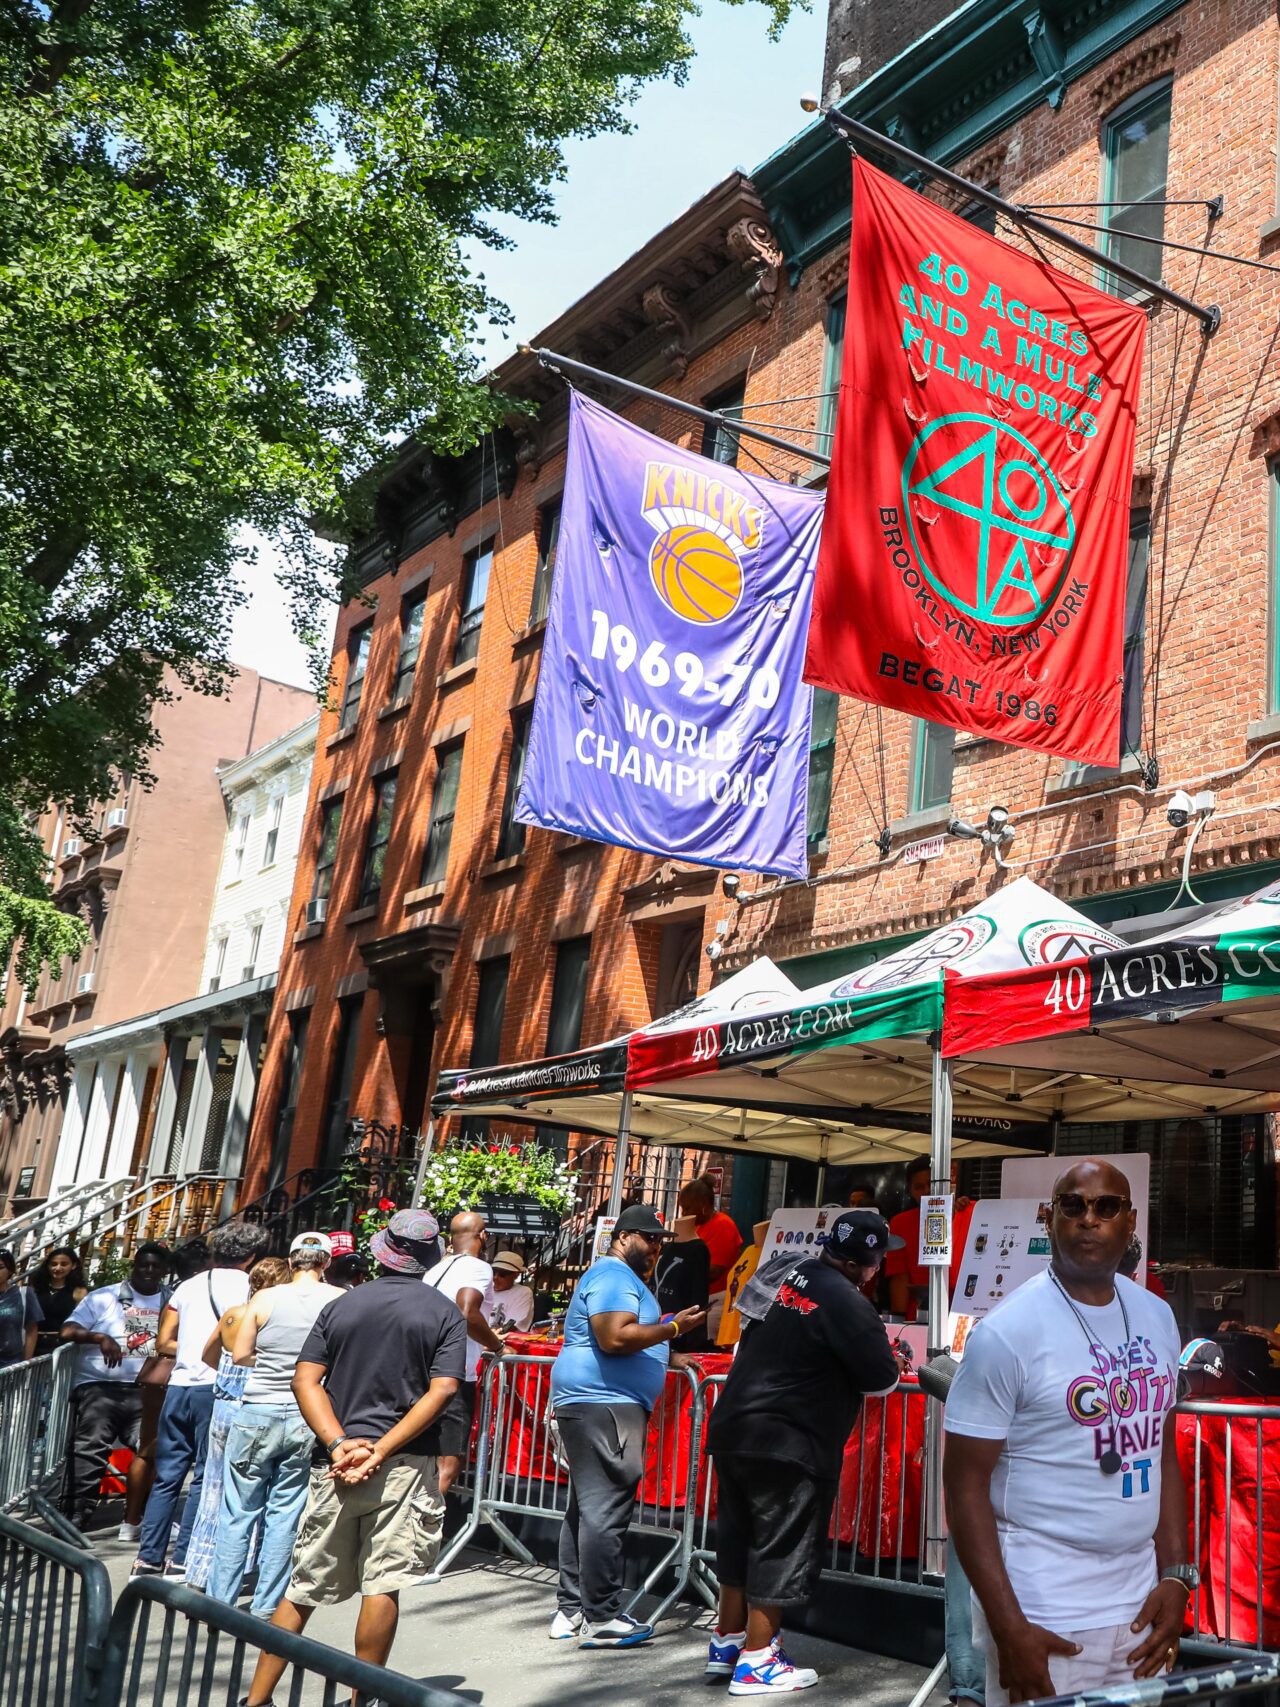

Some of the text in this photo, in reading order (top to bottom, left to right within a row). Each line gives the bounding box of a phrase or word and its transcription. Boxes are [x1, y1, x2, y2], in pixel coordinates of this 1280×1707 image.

[918, 251, 1089, 356] 40 ACRES
[899, 283, 1104, 402] AND A MULE
[900, 317, 1098, 438] FILMWORKS
[643, 462, 761, 550] KNICKS
[878, 506, 1089, 656] BROOKLYN, NEW YORK
[591, 608, 781, 710] 1969-70
[877, 651, 1059, 727] BEGAT 1986
[623, 695, 741, 762] WORLD
[575, 728, 770, 809] CHAMPIONS
[906, 838, 943, 861] SHAFTWAY
[1043, 966, 1085, 1015] 40
[692, 1027, 718, 1063] 40
[718, 1000, 854, 1058] ACRES.COM
[923, 1246, 948, 1255] SCAN ME
[1089, 1336, 1158, 1376] SHE'S
[1093, 1416, 1161, 1460] HAVE
